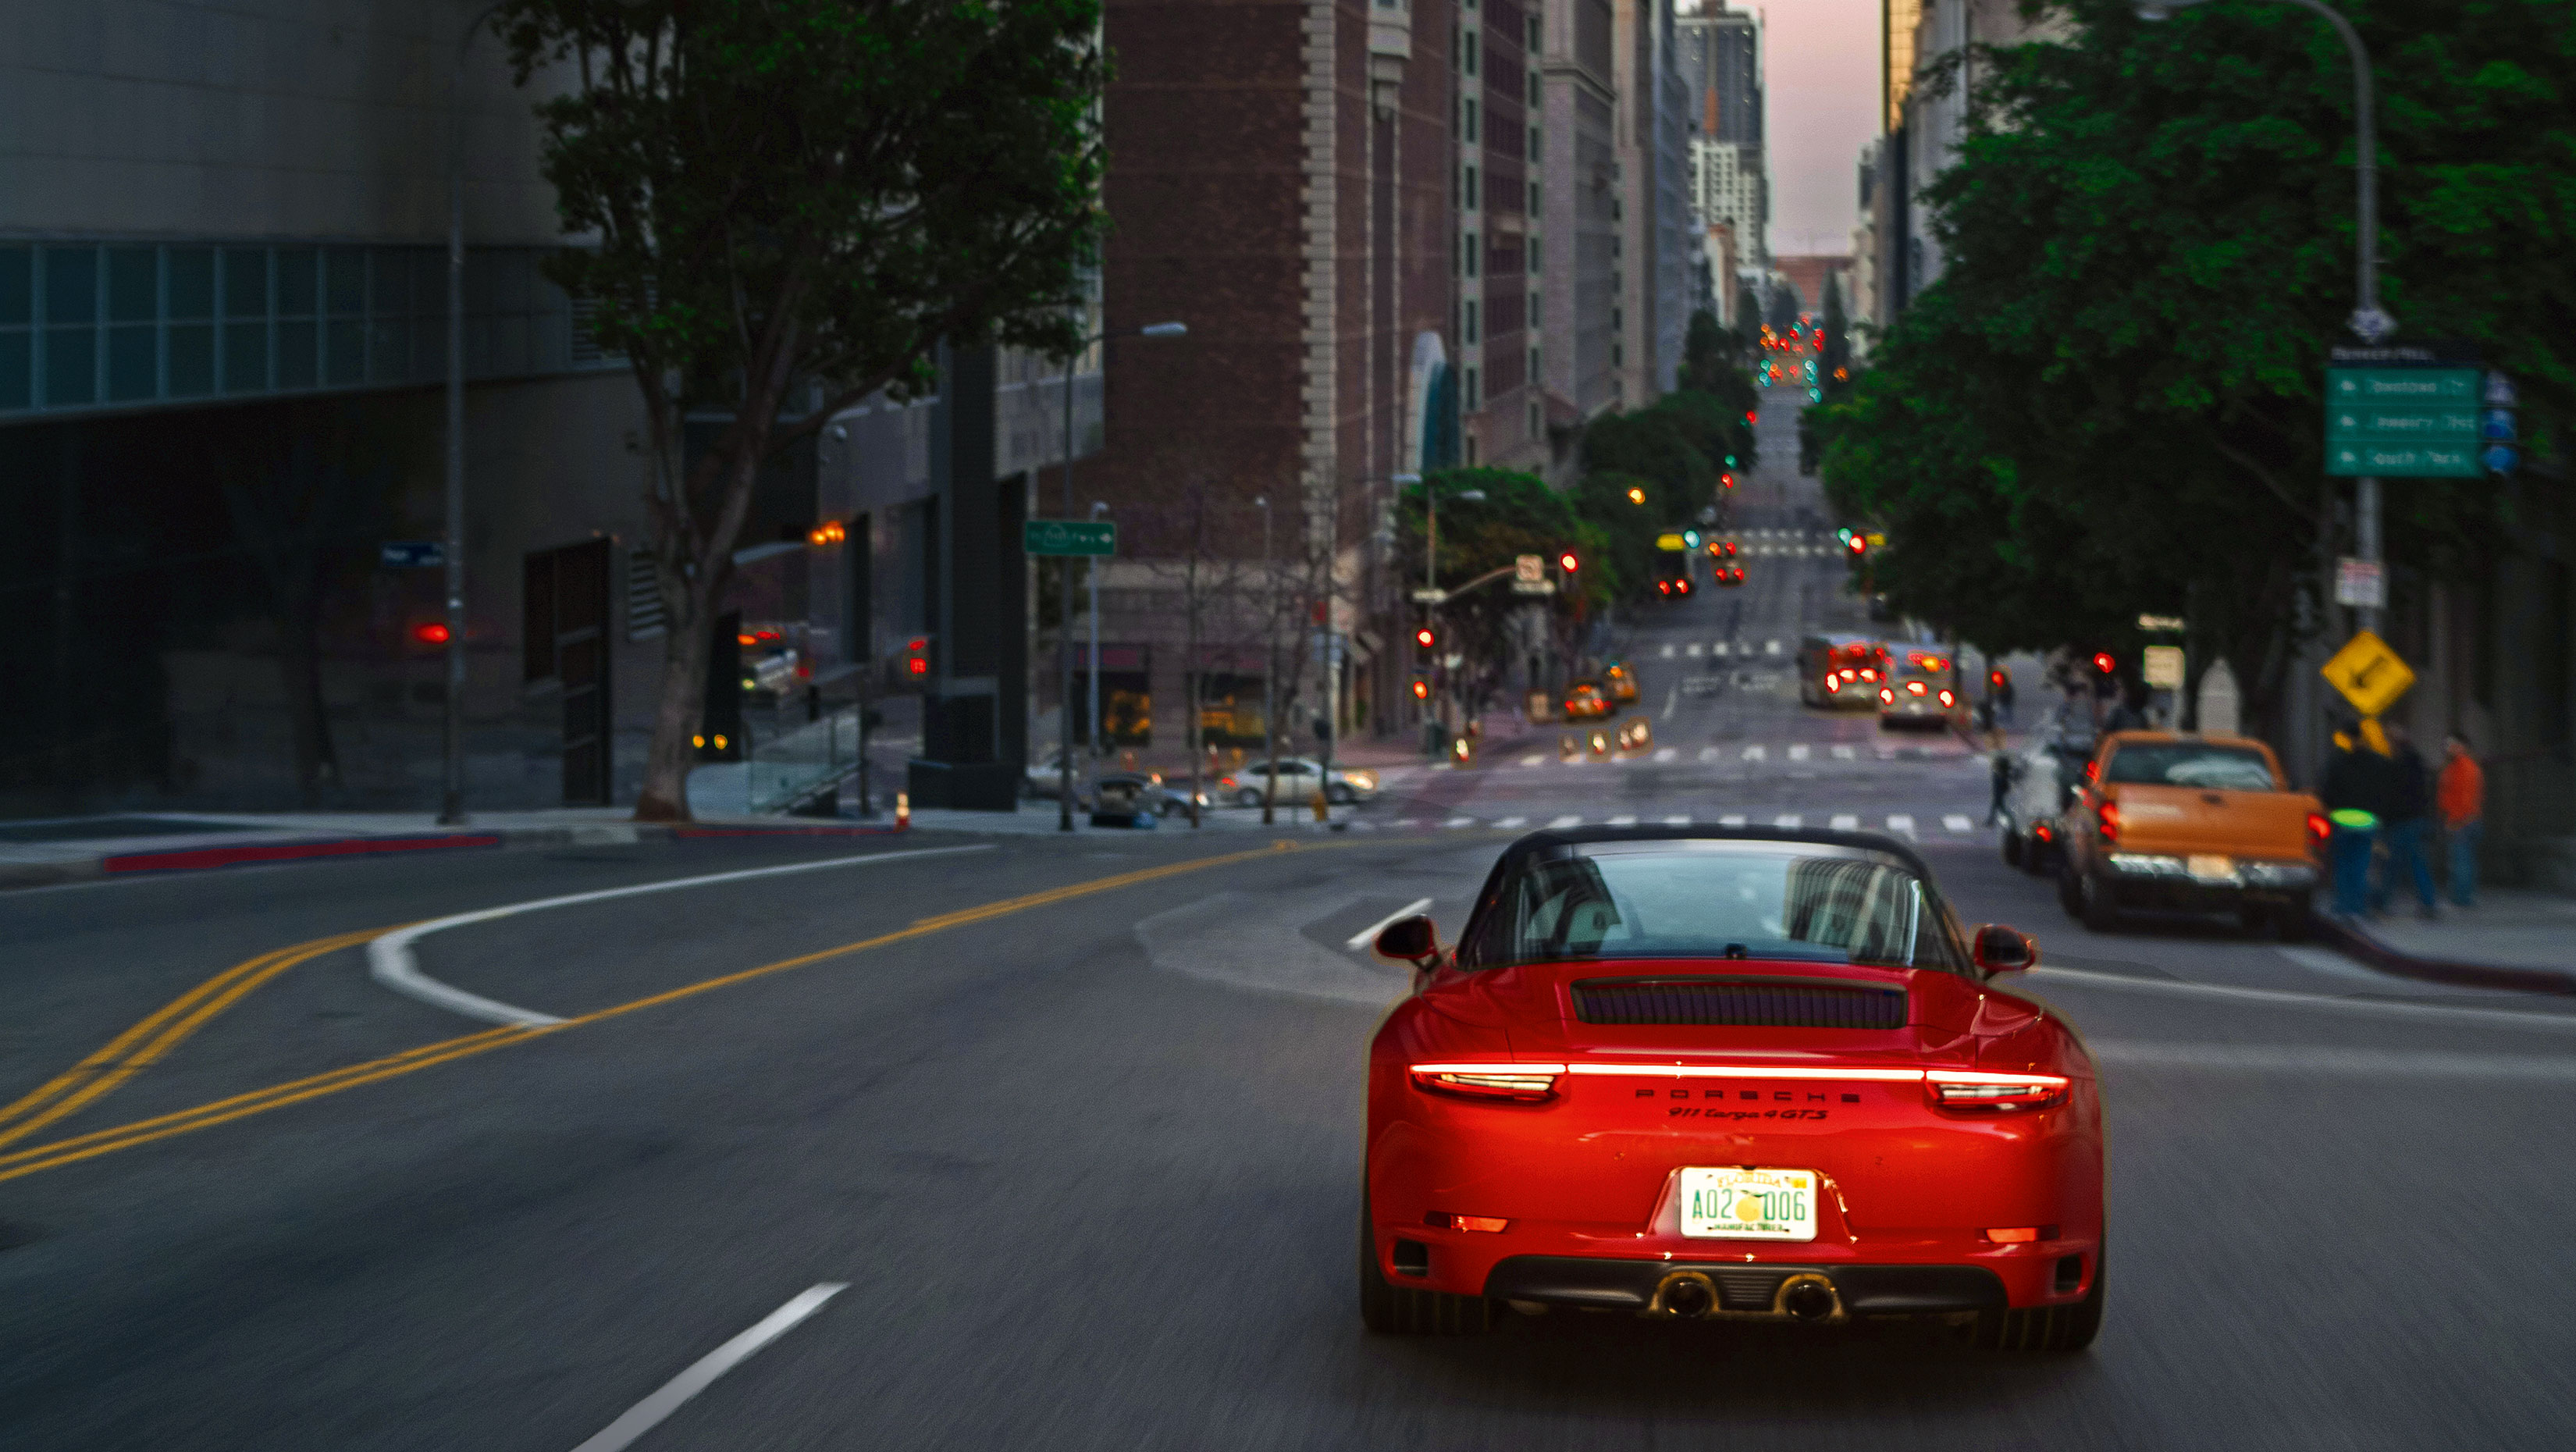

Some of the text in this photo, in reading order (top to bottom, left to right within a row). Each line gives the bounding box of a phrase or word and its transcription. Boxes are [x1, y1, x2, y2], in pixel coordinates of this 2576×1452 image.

[1635, 1089, 1860, 1103] PORSCHE
[1669, 1107, 1700, 1117] 911
[1780, 1109, 1827, 1119] GTS
[1717, 1172, 1781, 1188] FLORIDA
[1692, 1188, 1806, 1221] A02 006
